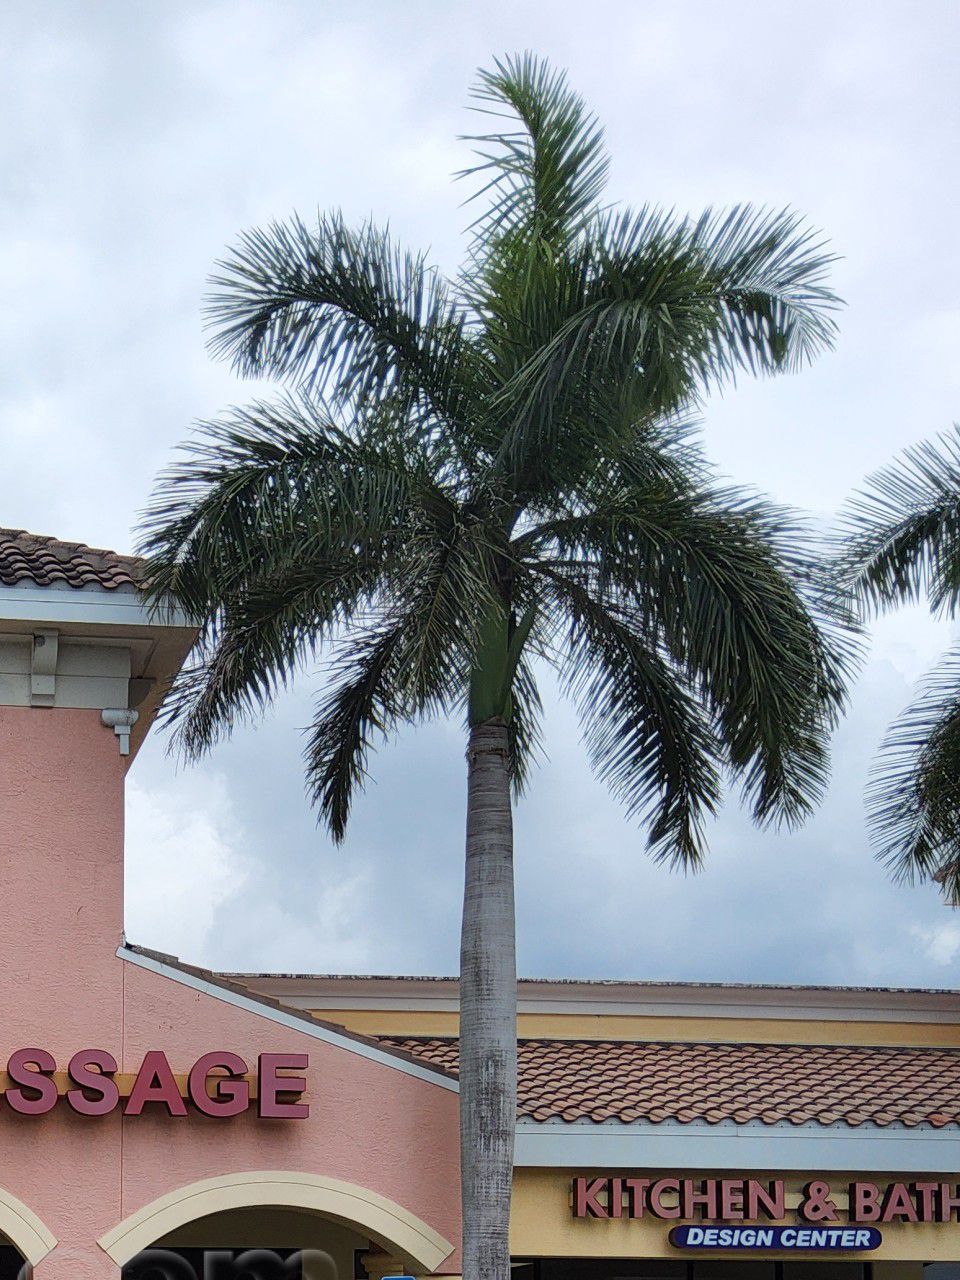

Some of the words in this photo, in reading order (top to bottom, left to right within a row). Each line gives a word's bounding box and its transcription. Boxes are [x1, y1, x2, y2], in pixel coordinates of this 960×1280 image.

[572, 1177, 785, 1220] KITCHEN
[798, 1179, 840, 1222] &
[686, 1227, 774, 1246] DESIGN
[780, 1229, 871, 1246] CENTER
